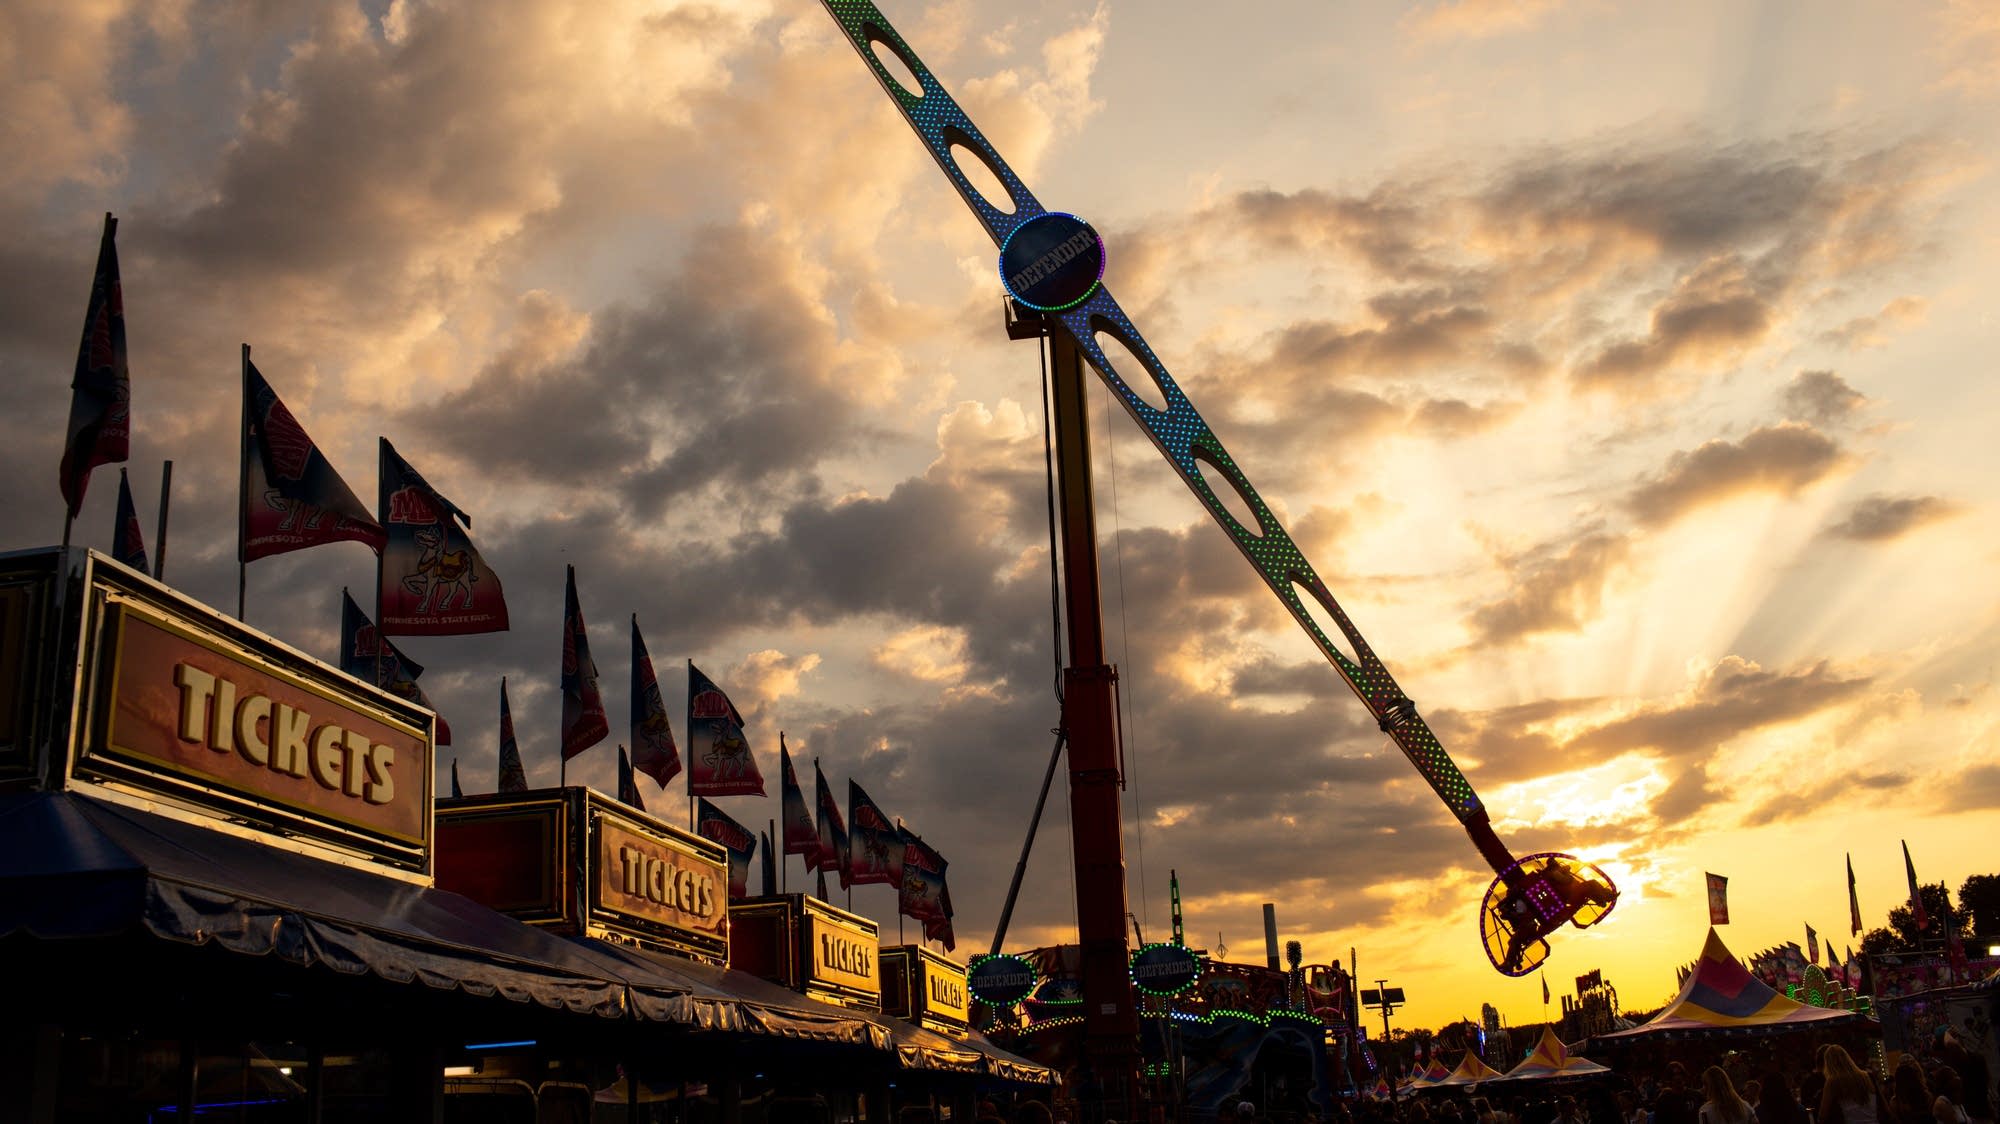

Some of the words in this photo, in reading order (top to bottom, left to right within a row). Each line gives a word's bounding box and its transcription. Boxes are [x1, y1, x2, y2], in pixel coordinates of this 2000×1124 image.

[1012, 229, 1096, 292] DEFENDER
[384, 616, 440, 625] MINNESOTA
[174, 663, 395, 805] TICKETS
[621, 847, 714, 918] TICKETS
[823, 933, 871, 978] TICKETS
[1139, 959, 1194, 979] DEFENDER
[930, 974, 963, 1010] TICKETS
[977, 973, 1031, 988] DEFENDER
